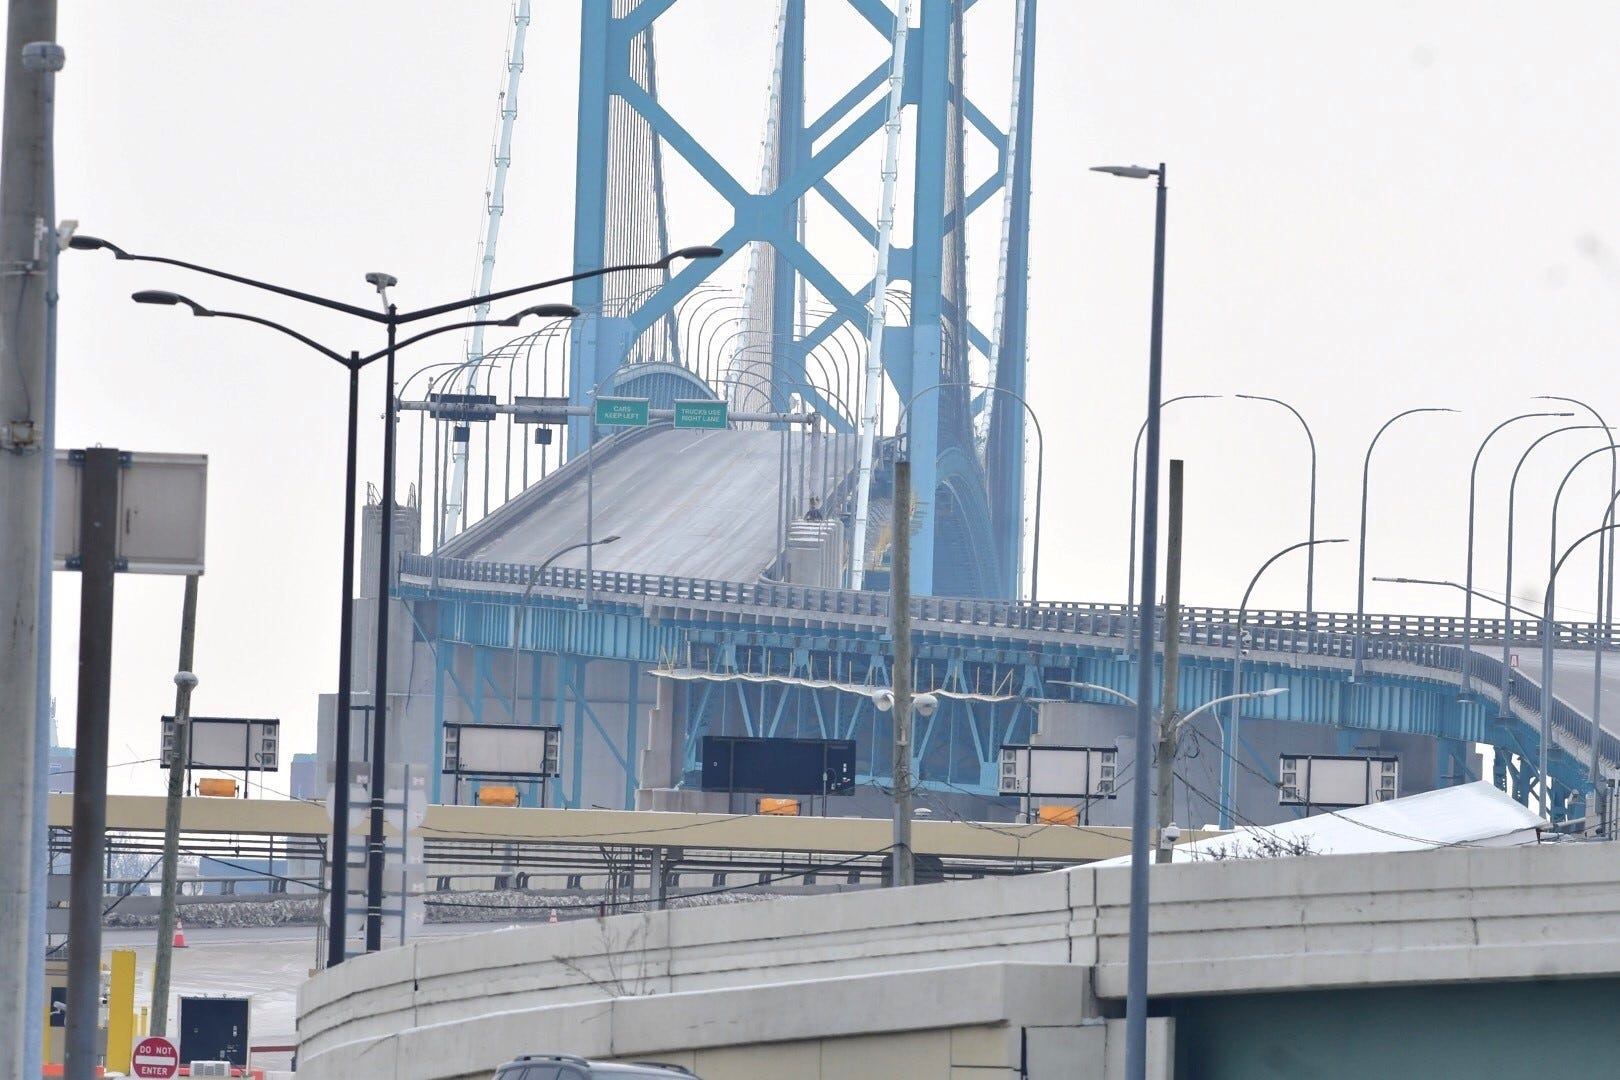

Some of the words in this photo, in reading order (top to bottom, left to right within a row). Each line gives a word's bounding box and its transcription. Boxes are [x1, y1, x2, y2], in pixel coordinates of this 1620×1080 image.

[139, 1045, 152, 1054] DO
[156, 1046, 172, 1055] NOT
[141, 1066, 168, 1076] ENTER
